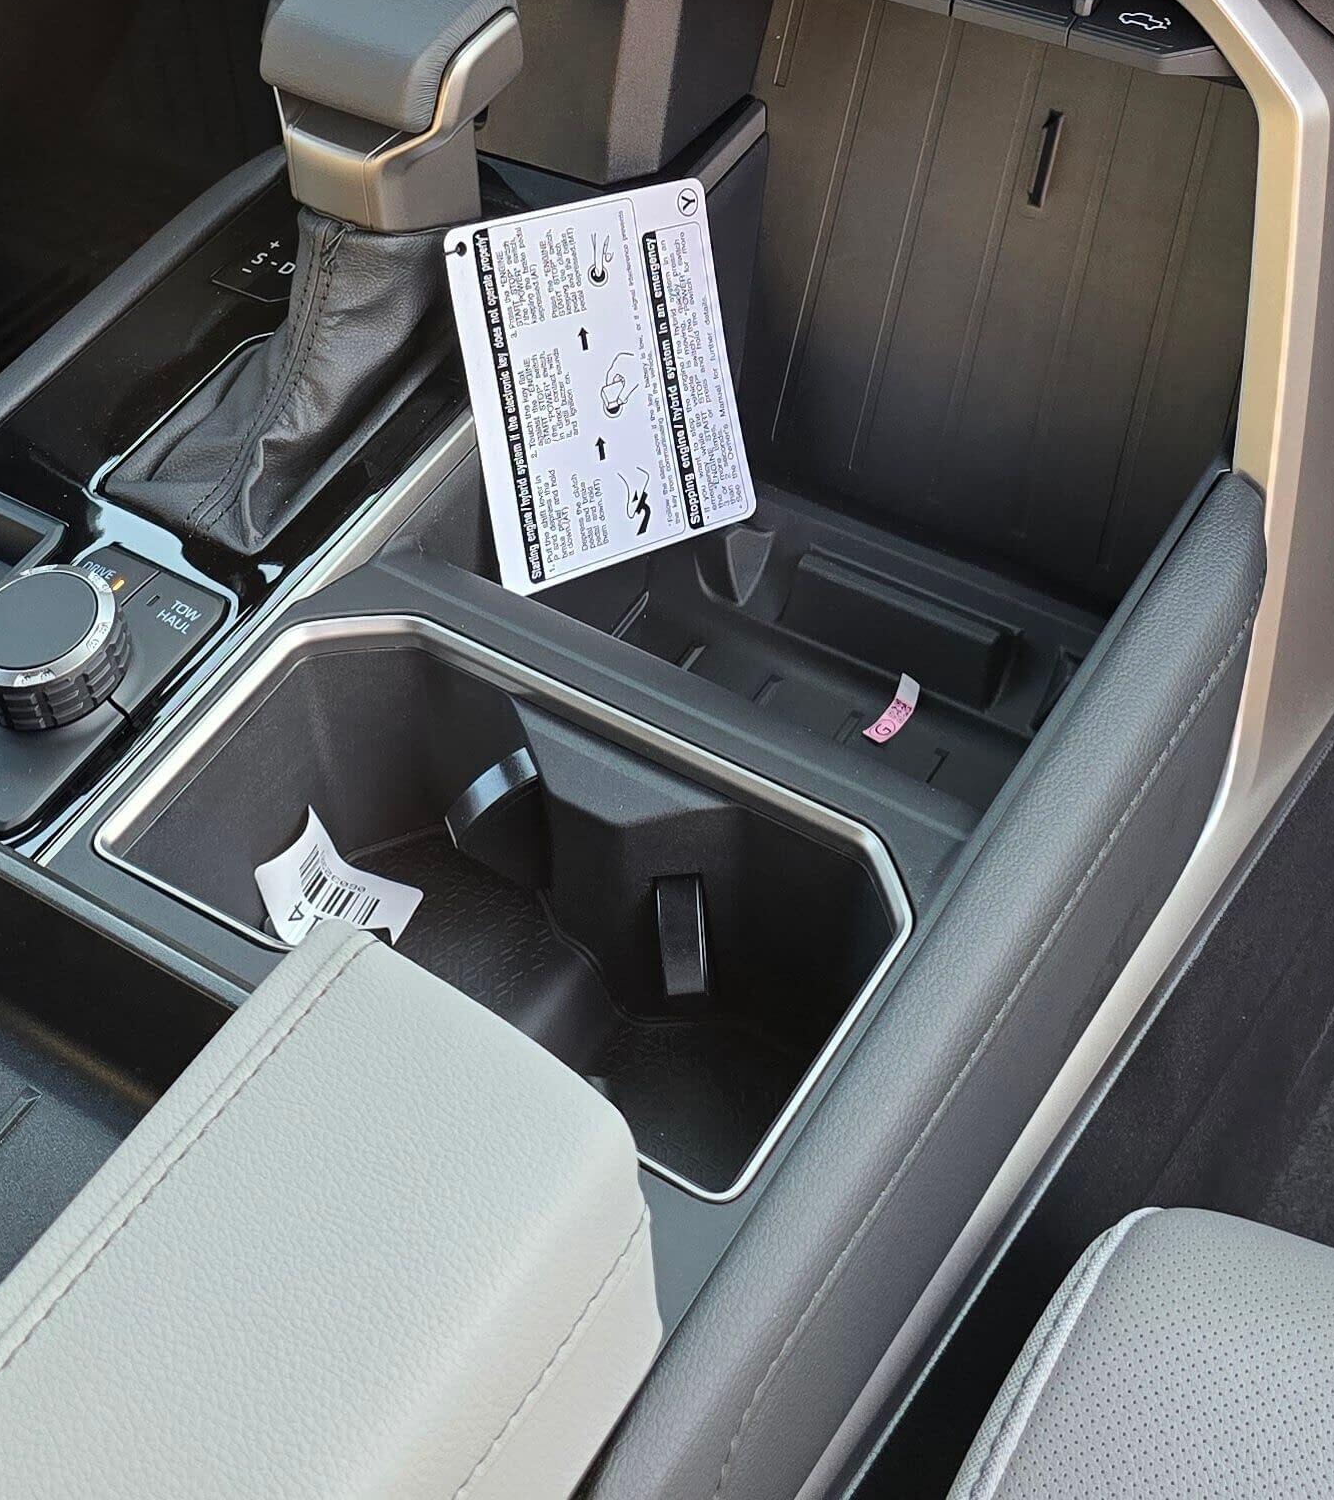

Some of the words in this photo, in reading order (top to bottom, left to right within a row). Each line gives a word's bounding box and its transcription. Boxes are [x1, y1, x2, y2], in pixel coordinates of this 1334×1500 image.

[681, 196, 695, 211] Y
[251, 252, 267, 266] S
[278, 261, 296, 274] D
[646, 238, 662, 298] emergency
[483, 274, 498, 306] operate
[488, 308, 500, 324] not
[657, 303, 665, 318] an
[493, 327, 504, 348] does
[659, 322, 668, 334] in
[497, 353, 508, 369] key
[662, 339, 676, 379] system
[500, 371, 515, 413] electronic
[667, 385, 682, 421] hybrid
[508, 416, 518, 431] the
[513, 443, 527, 475] system
[685, 473, 700, 524] Stopping
[82, 561, 117, 580] DRIVE
[529, 544, 542, 579] Starting
[157, 608, 189, 634] HAUL
[170, 599, 202, 621] TOW
[875, 722, 892, 736] G
